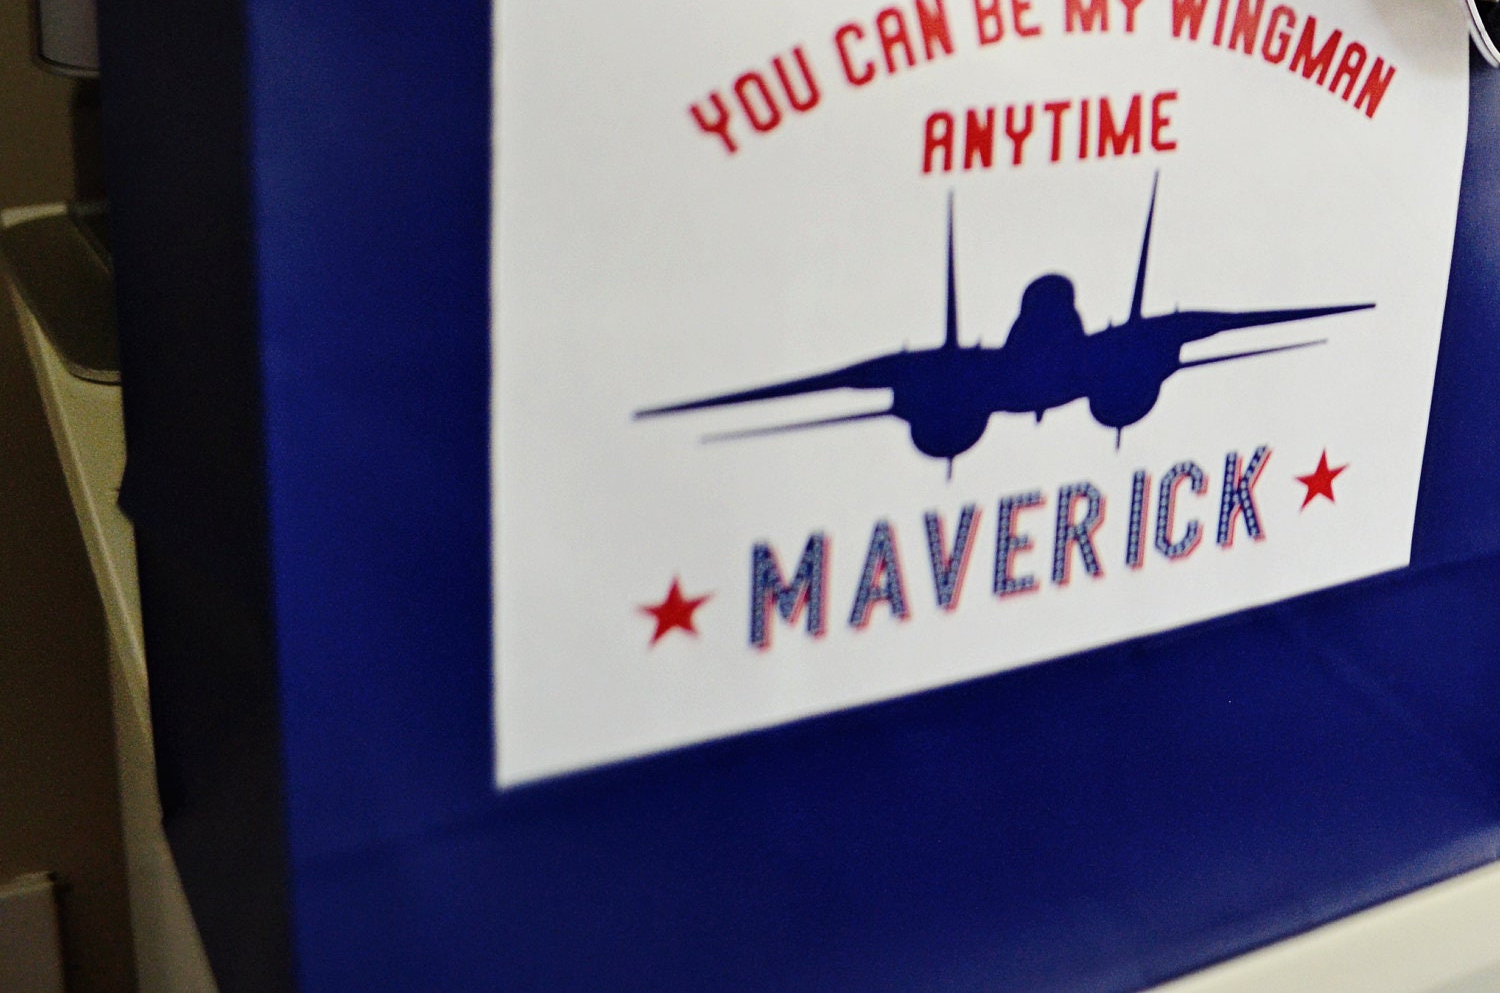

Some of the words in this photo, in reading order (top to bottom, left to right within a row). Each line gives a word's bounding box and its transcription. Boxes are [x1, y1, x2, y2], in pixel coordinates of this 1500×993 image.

[688, 44, 823, 156] YOU
[920, 89, 1180, 176] ANYTIME
[747, 445, 1274, 650] MAVERICK
